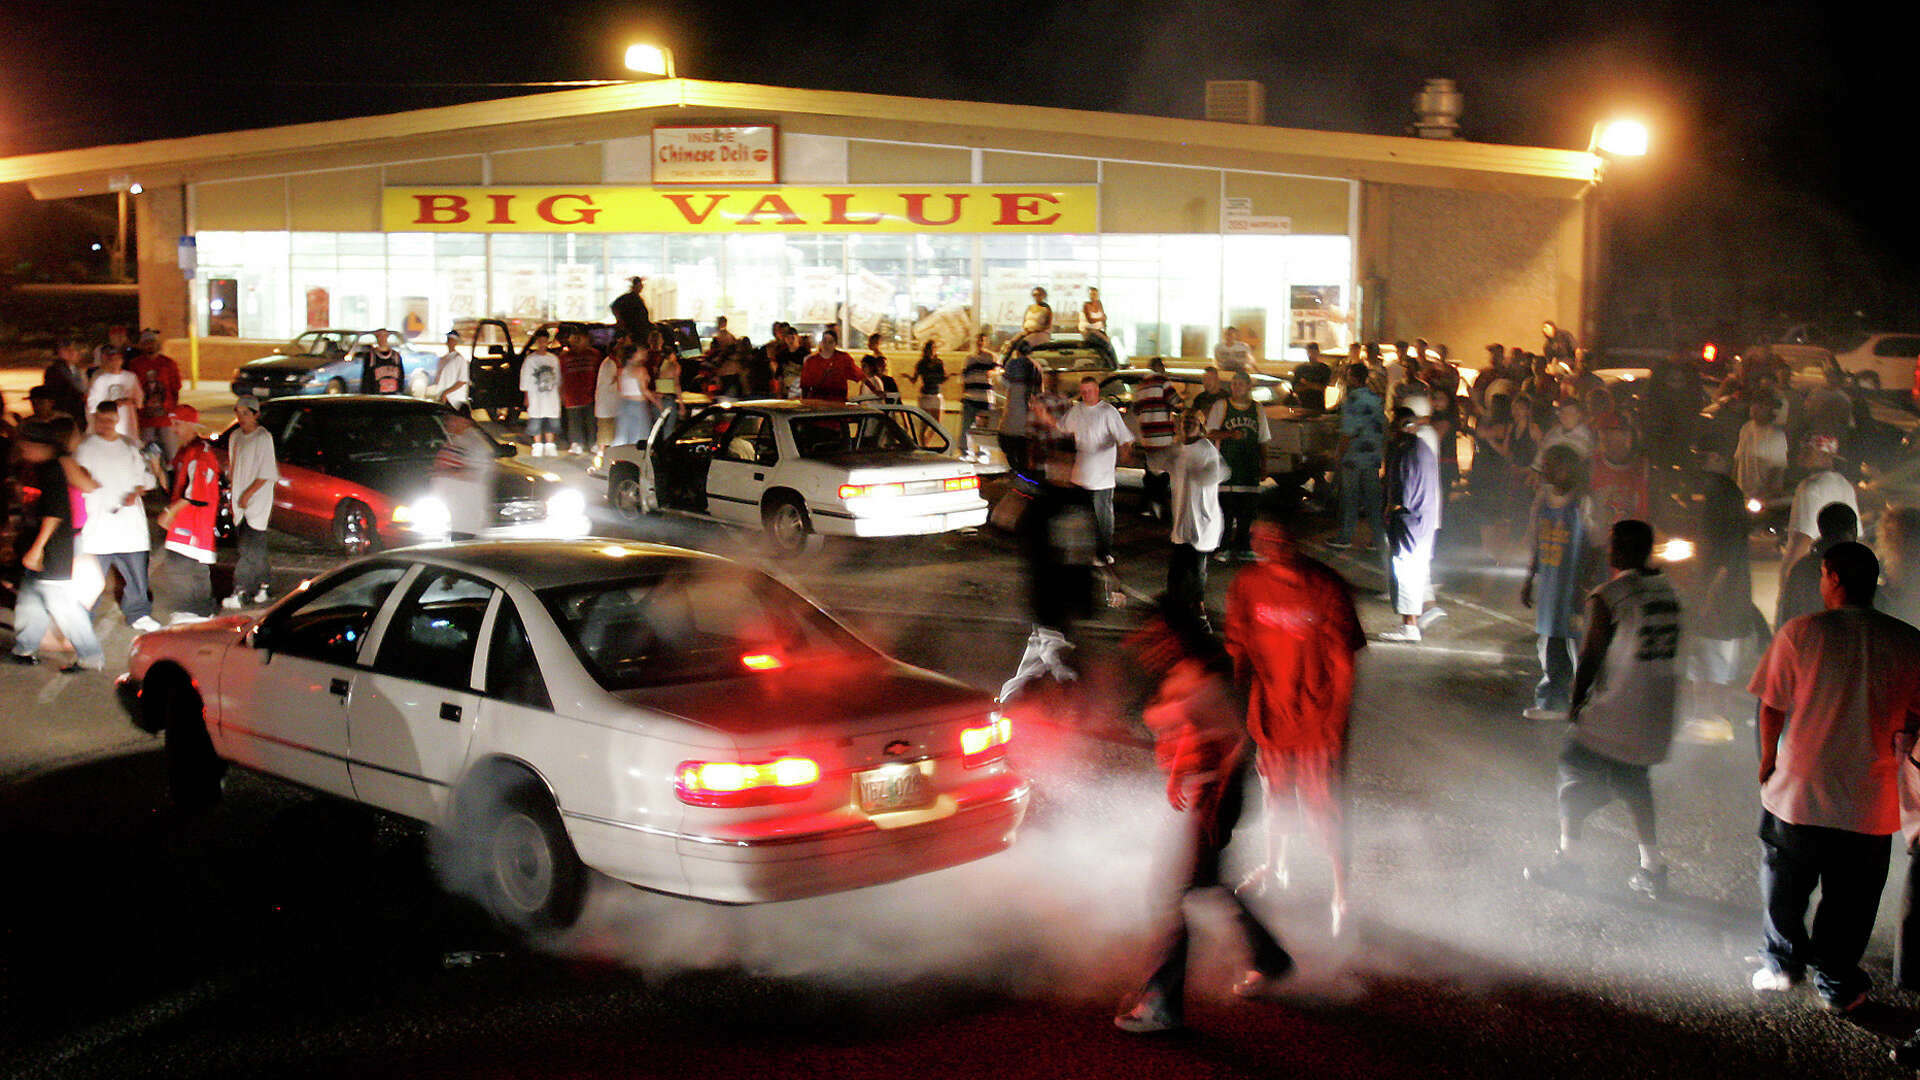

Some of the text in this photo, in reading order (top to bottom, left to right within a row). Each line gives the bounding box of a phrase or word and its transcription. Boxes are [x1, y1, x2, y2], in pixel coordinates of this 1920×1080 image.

[659, 144, 749, 163] Chinese Deli
[411, 194, 1063, 226] BIG VALUE
